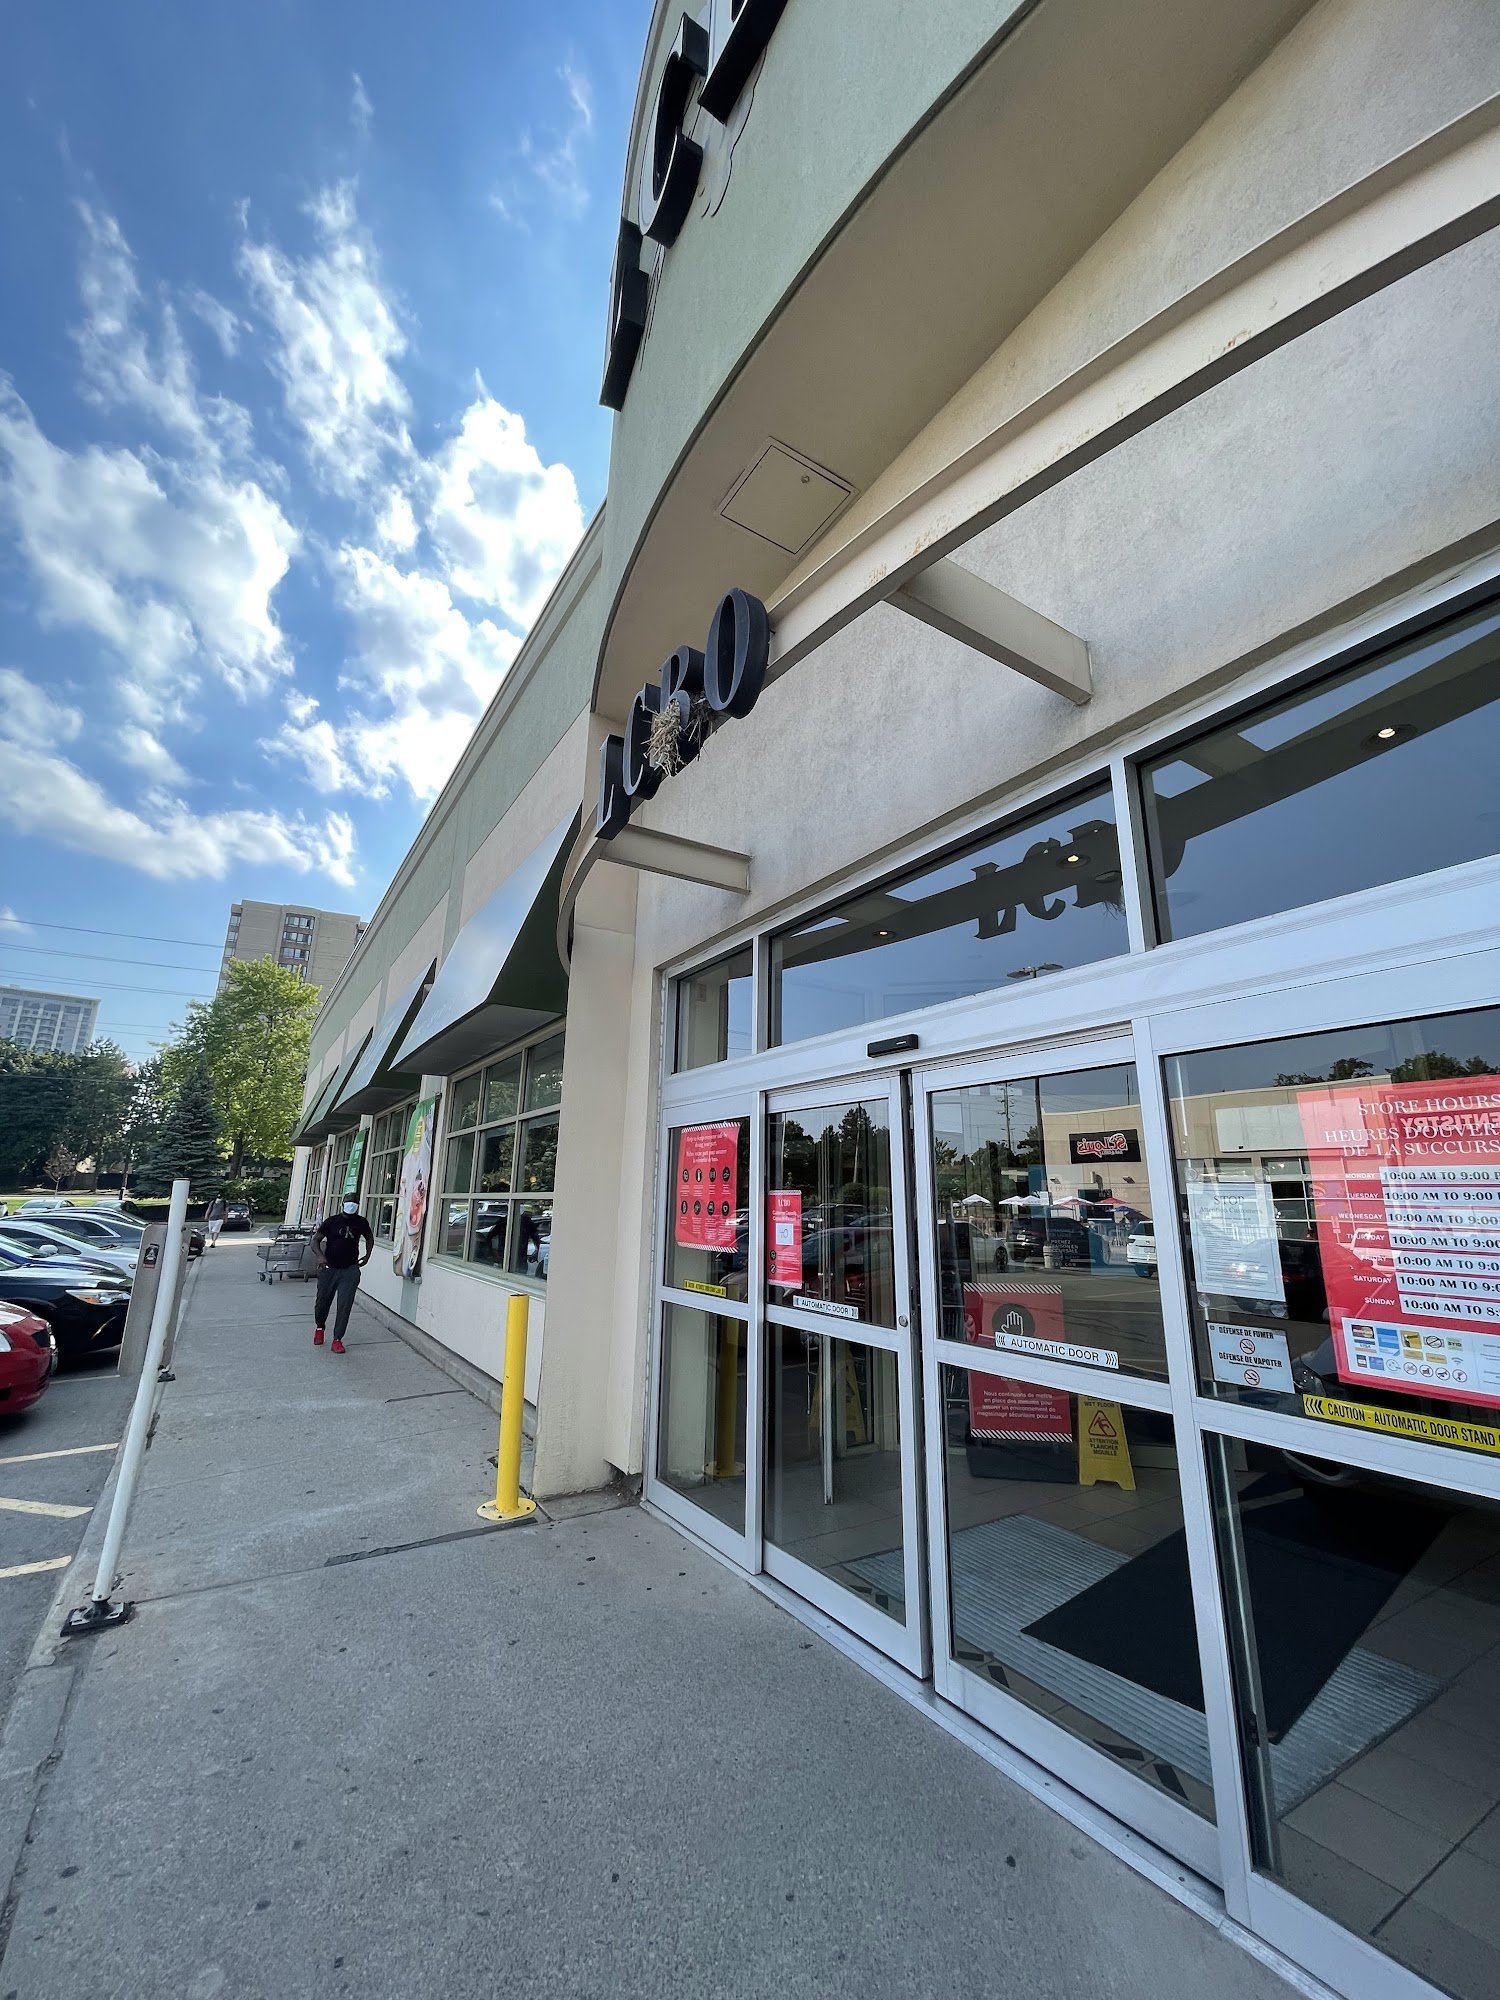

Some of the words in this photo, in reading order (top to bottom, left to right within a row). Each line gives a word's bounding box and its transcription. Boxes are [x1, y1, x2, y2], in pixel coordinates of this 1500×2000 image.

[1358, 1099, 1422, 1117] STORE
[1427, 1093, 1500, 1113] HOURS
[1324, 1127, 1399, 1143] HEURES
[1342, 1145, 1368, 1157] DE
[1376, 1144, 1401, 1156] LA
[1404, 1139, 1500, 1156] SUCCURS
[1383, 1171, 1416, 1180] 10:00
[1419, 1171, 1437, 1180] AM
[1439, 1171, 1456, 1180] TO
[1460, 1171, 1490, 1180] 9:00
[1385, 1192, 1418, 1201] 10:00
[1422, 1192, 1439, 1201] AM
[1443, 1192, 1459, 1201] TO
[1463, 1192, 1493, 1201] 9:00
[1338, 1212, 1383, 1220] WEDNESDAY
[1388, 1213, 1422, 1223] 10:00
[1426, 1213, 1443, 1224] AM
[1446, 1214, 1464, 1224] TO
[1468, 1215, 1499, 1225] 9:00
[1392, 1234, 1427, 1246] 10:00
[1430, 1235, 1449, 1247] AM
[1451, 1236, 1468, 1248] TO
[1396, 1255, 1431, 1267] 10:00
[1435, 1257, 1453, 1269] AM
[1456, 1259, 1474, 1270] TO
[1353, 1274, 1392, 1284] SATURDAY
[1399, 1275, 1435, 1287] 10:00
[1439, 1277, 1457, 1289] AM
[1460, 1279, 1478, 1291] TO
[801, 1299, 832, 1312] AUTOMATIC
[832, 1304, 849, 1315] DOOR
[1364, 1296, 1396, 1306] SUNDAY
[1402, 1298, 1440, 1311] 10:00
[1443, 1301, 1461, 1314] AM
[1464, 1303, 1482, 1316] TO
[1244, 1328, 1252, 1337] DE
[1252, 1329, 1275, 1340] FUMER
[1010, 1338, 1066, 1355] AUTOMATIC
[1068, 1348, 1100, 1362] DOOR
[1244, 1354, 1253, 1364] DE
[1253, 1356, 1283, 1368] VAPOTER
[1327, 1402, 1366, 1422] CAUTION
[1373, 1411, 1428, 1434] AUTOMATIC
[1429, 1421, 1460, 1440] DOOR
[1461, 1427, 1496, 1447] STAND
